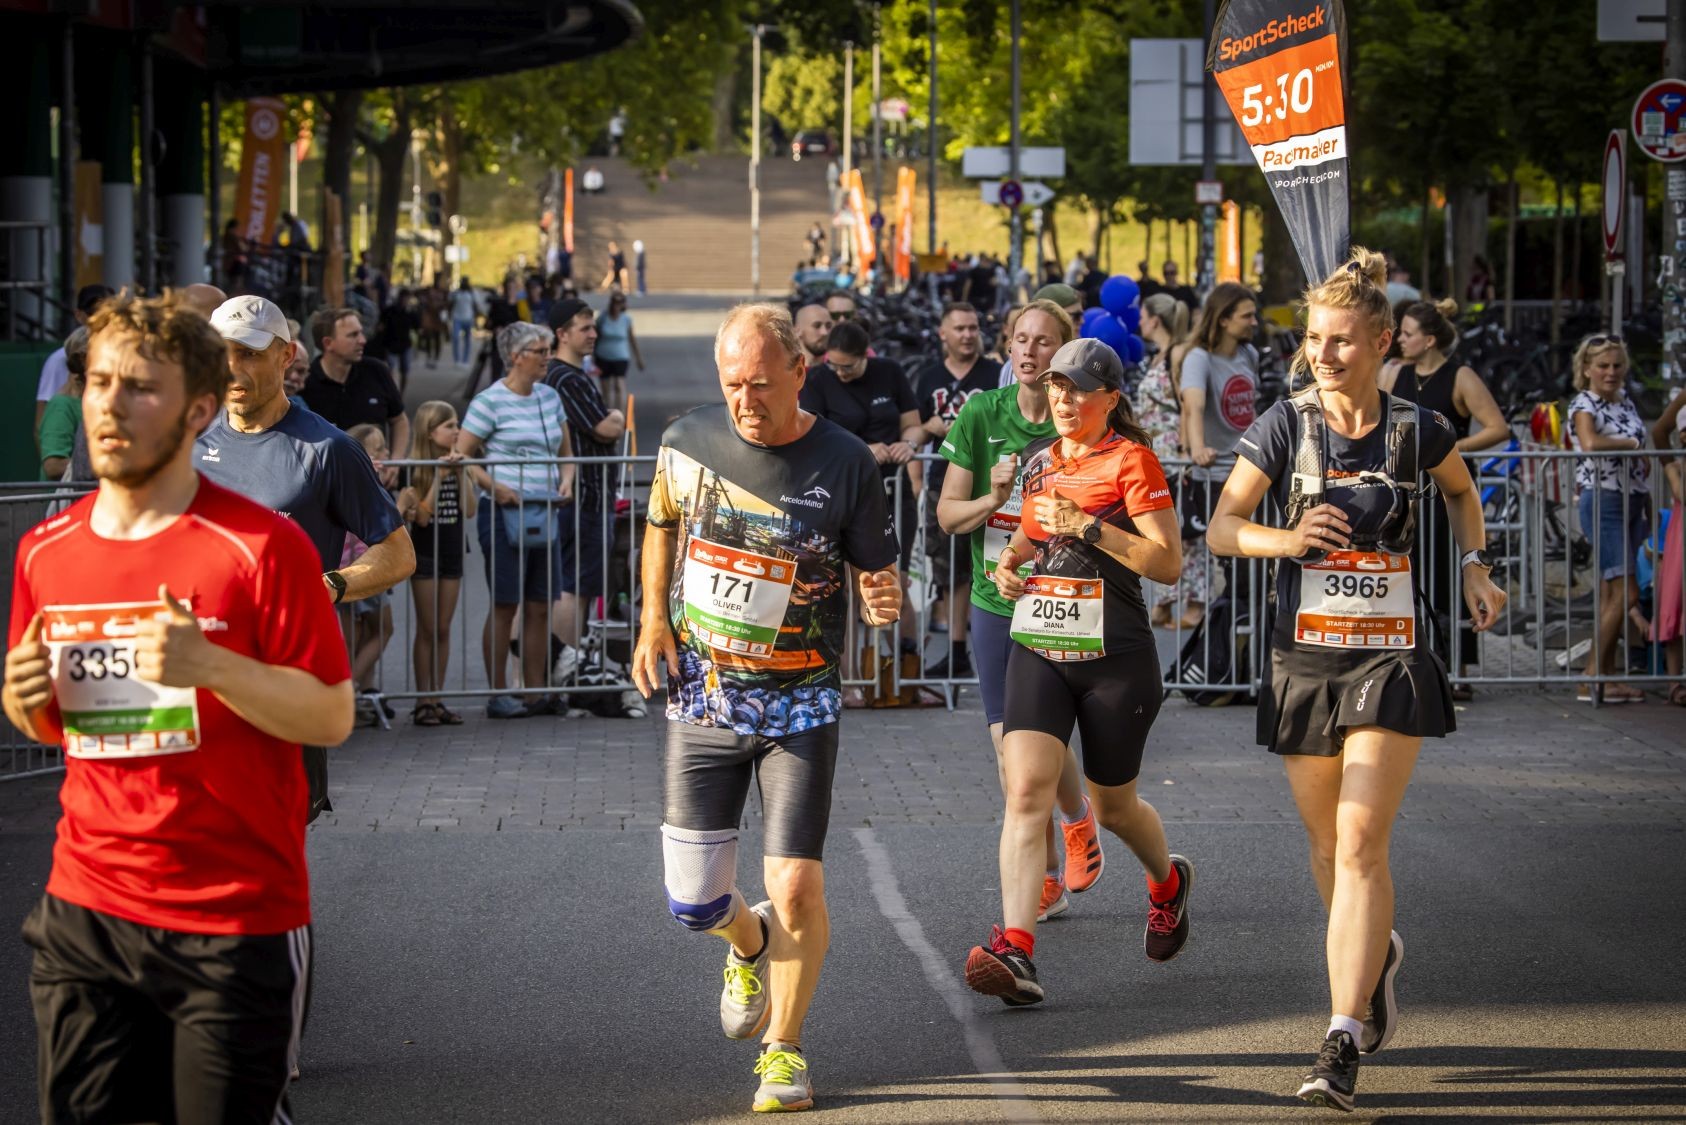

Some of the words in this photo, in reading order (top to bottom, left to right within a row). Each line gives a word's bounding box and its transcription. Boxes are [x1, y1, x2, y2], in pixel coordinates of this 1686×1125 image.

[1219, 4, 1326, 61] SportScheck
[1243, 68, 1313, 127] 5:30
[779, 494, 824, 509] ArcelorMittal
[710, 572, 754, 603] 171
[1324, 574, 1389, 599] 3965
[712, 599, 743, 612] OLIVER
[1032, 598, 1081, 621] 2054
[1043, 621, 1065, 629] DIANA
[1325, 620, 1359, 628] STARTZEIT
[1396, 620, 1406, 630] D
[68, 647, 140, 681] 335
